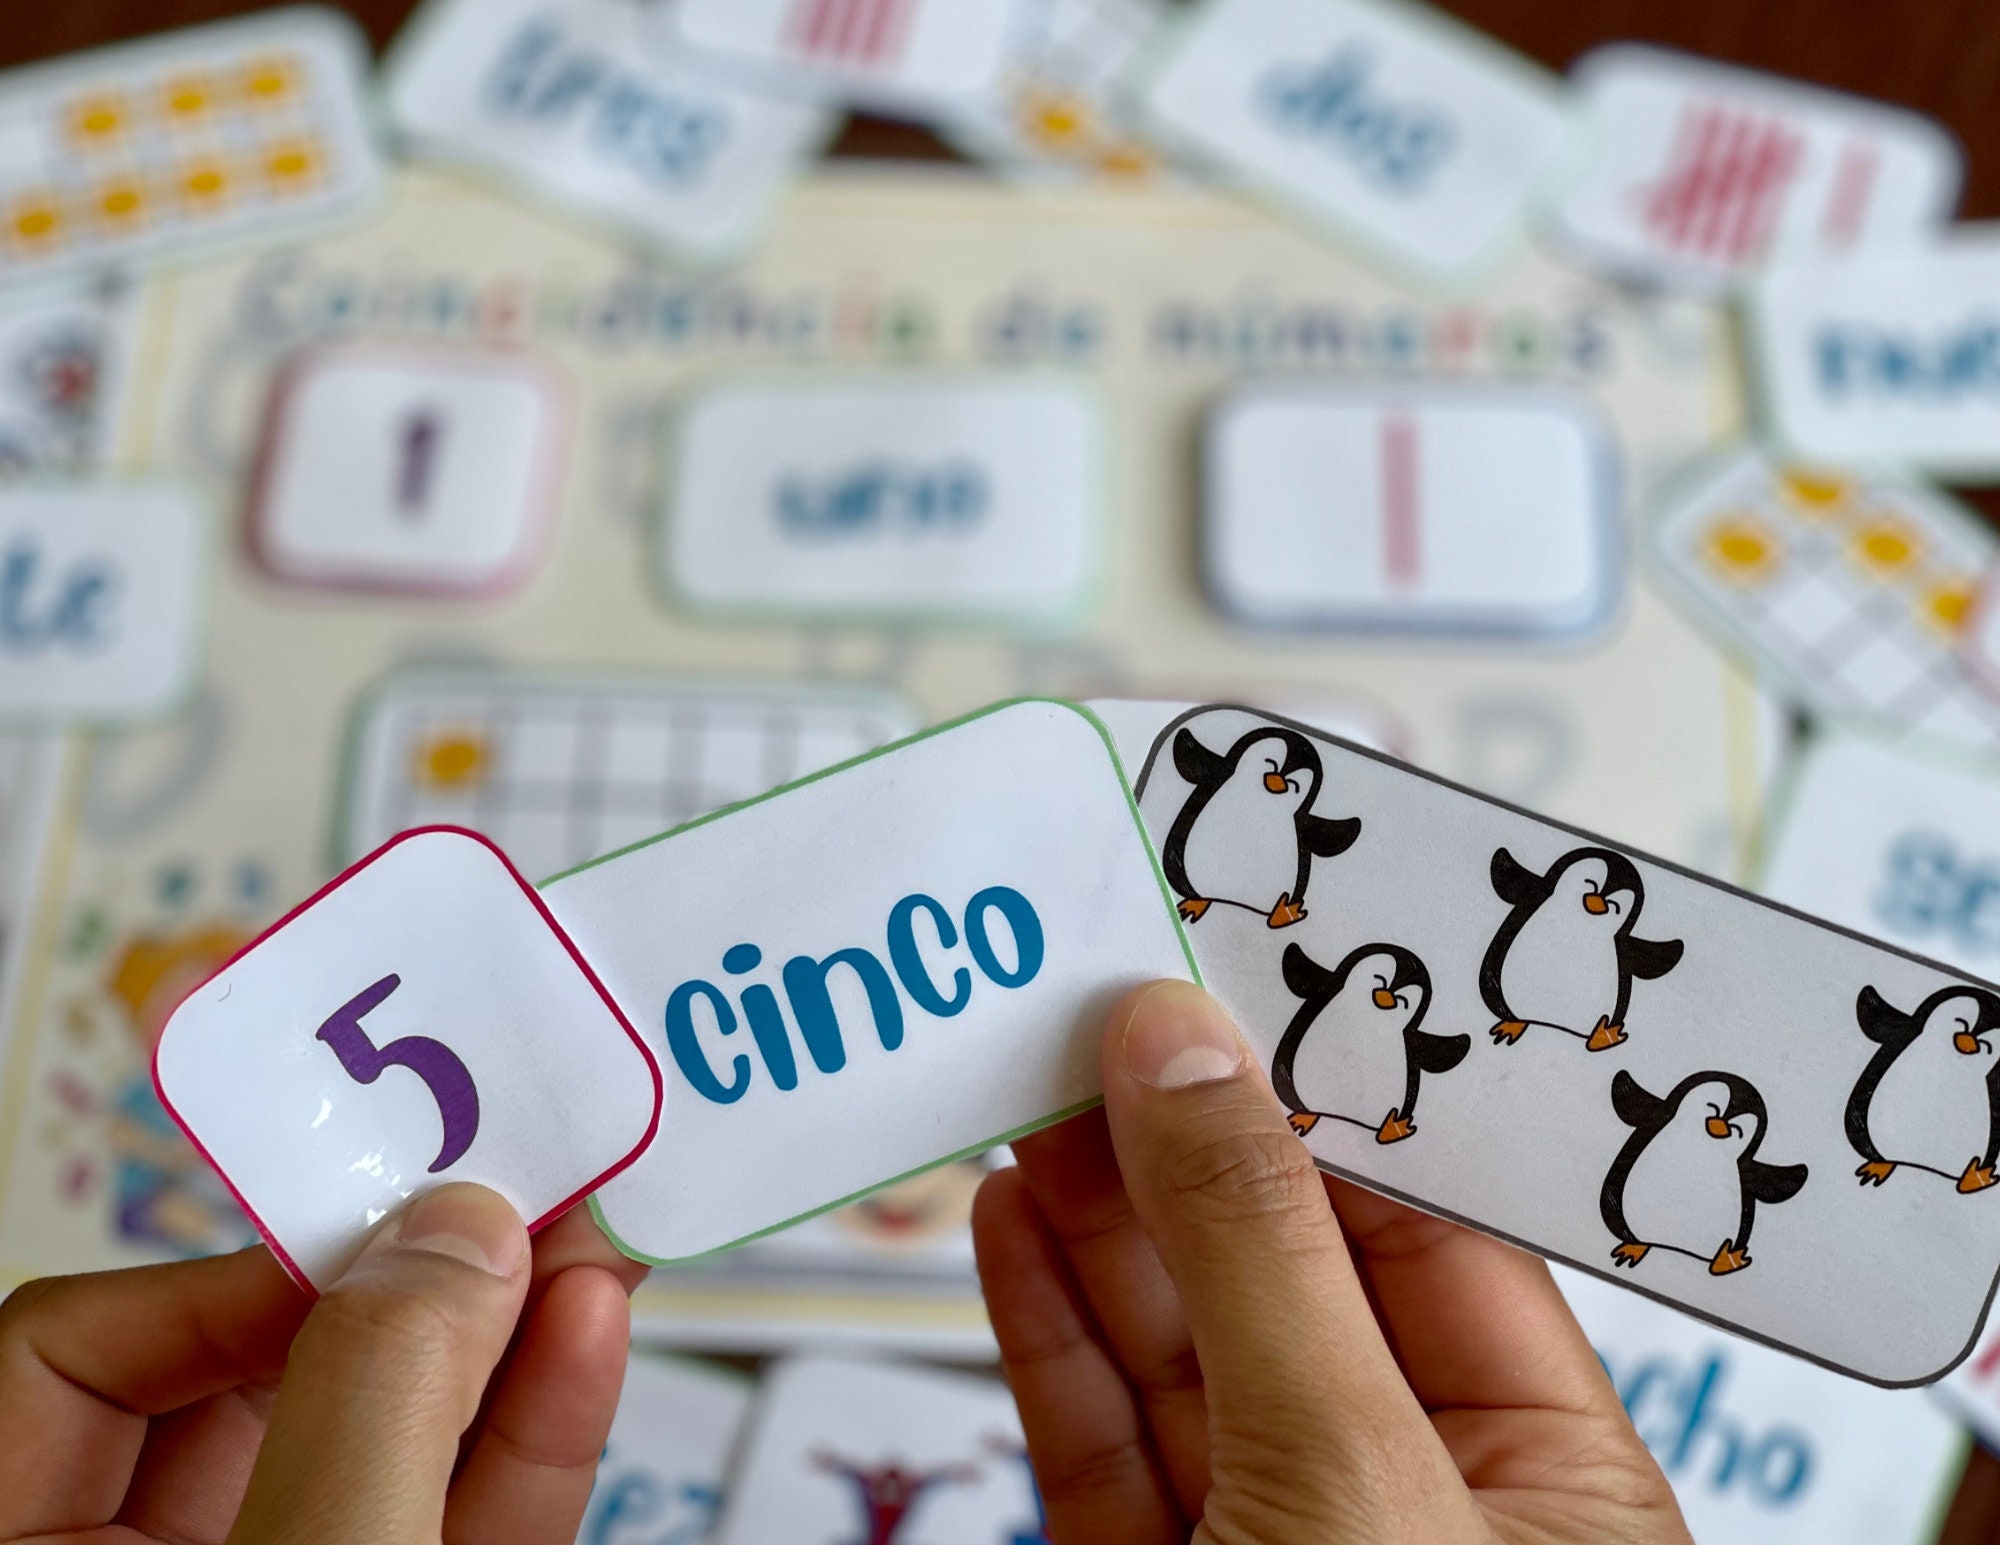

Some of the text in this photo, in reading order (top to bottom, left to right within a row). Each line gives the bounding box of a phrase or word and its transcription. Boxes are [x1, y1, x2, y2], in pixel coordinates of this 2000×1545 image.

[770, 455, 990, 548] uno
[316, 973, 479, 1172] 5
[666, 885, 1044, 1104] cinco
[1592, 1342, 1818, 1510] cho
